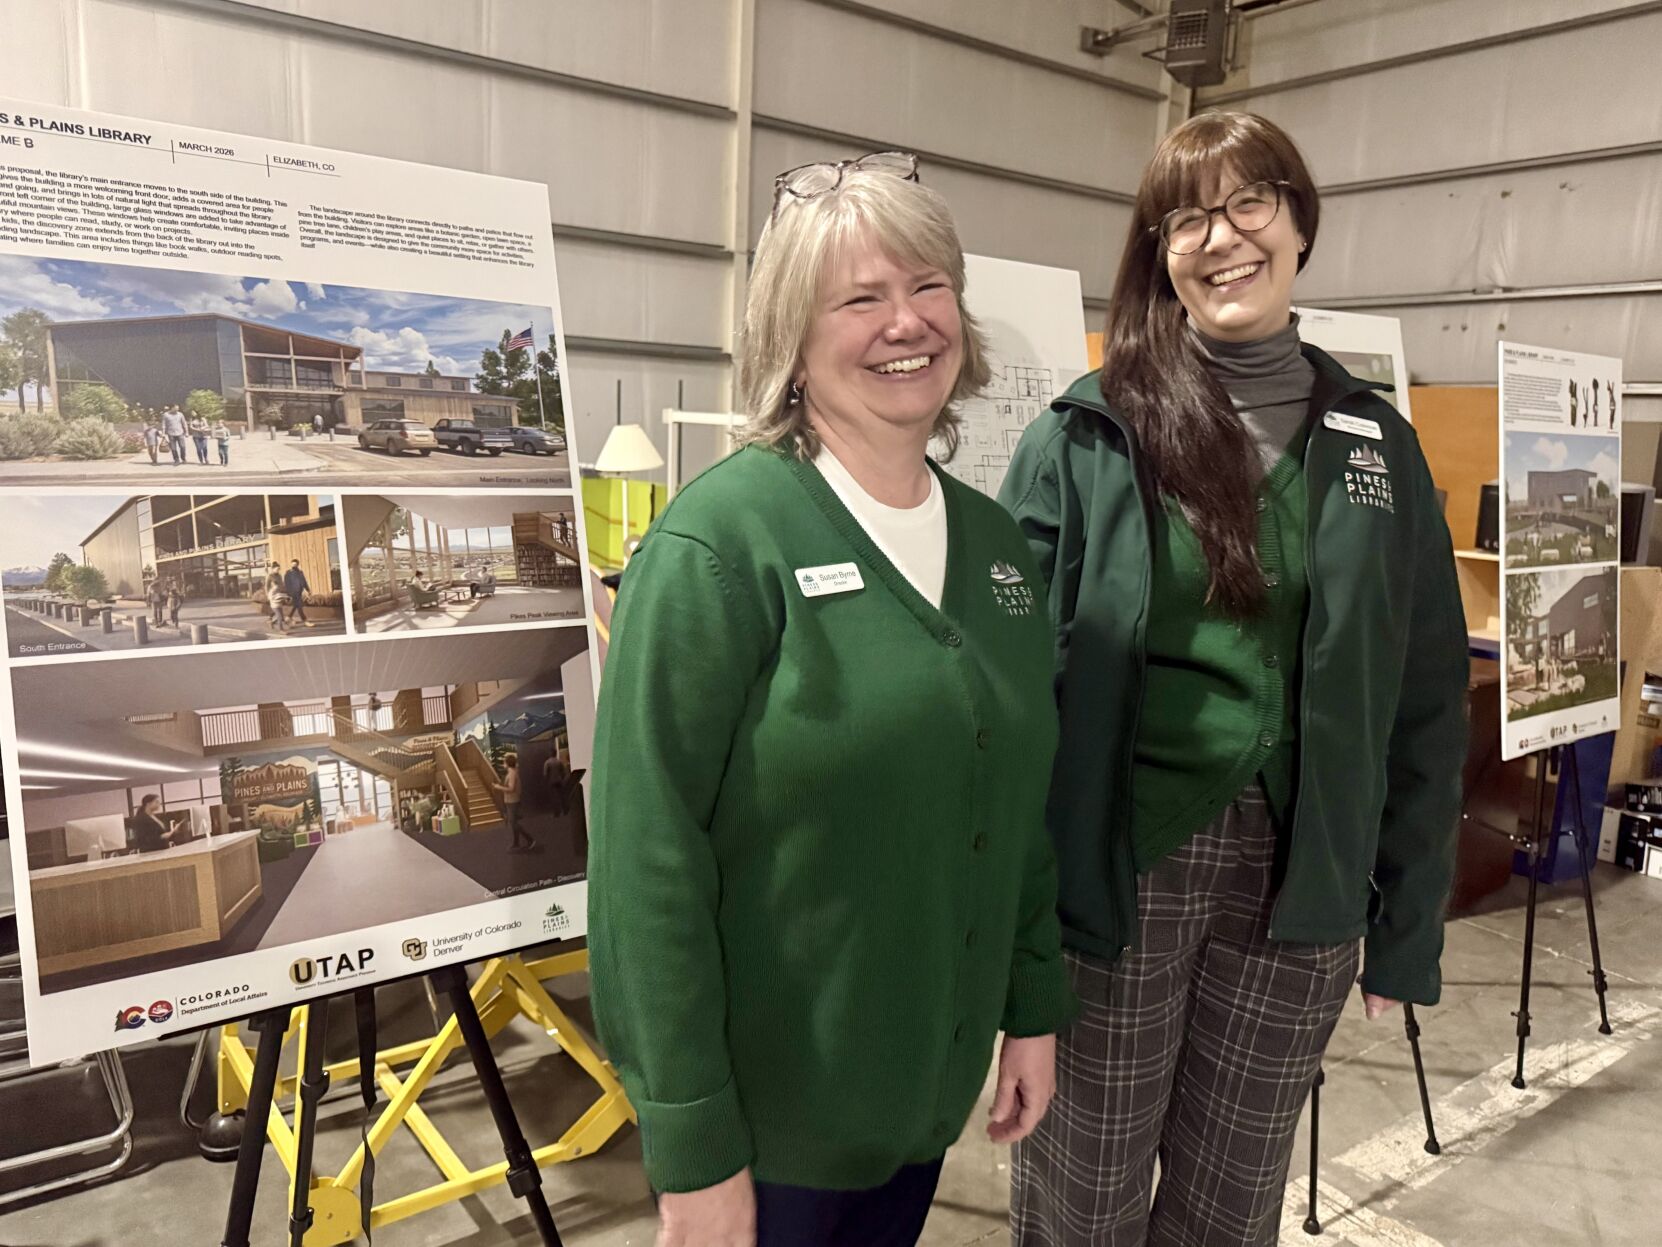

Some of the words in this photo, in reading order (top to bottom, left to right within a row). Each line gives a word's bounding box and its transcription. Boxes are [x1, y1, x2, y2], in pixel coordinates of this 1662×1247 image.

[0, 112, 9, 124] S
[14, 115, 25, 126] &
[29, 117, 84, 135] PLAINS
[89, 126, 152, 144] LIBRARY
[0, 134, 21, 146] ME
[24, 138, 34, 148] B
[178, 142, 212, 153] MARCH
[214, 147, 235, 157] 2026
[273, 156, 321, 170] ELIZABETH,
[322, 164, 335, 172] CO
[59, 171, 89, 182] library's
[110, 179, 142, 188] entrance
[35, 176, 65, 188] building
[95, 185, 133, 197] welcoming
[135, 189, 151, 197] front
[252, 206, 274, 214] people
[58, 188, 81, 198] brings
[115, 196, 140, 204] natural
[142, 198, 156, 207] light
[202, 206, 238, 216] throughout
[30, 194, 56, 202] corner
[113, 203, 131, 213] large
[133, 206, 152, 214] glass
[154, 208, 184, 217] windows
[198, 214, 220, 222] added
[245, 219, 278, 230] advantage
[20, 235, 43, 243] where
[46, 237, 74, 247] families
[92, 244, 112, 252] enjoy
[131, 246, 160, 256] together
[100, 235, 130, 244] includes
[132, 238, 154, 248] things
[238, 251, 262, 260] reading
[1345, 472, 1386, 489] PINES
[1347, 483, 1393, 503] PLAINS
[992, 586, 1026, 596] PINES
[996, 596, 1033, 606] PLAIN
[234, 786, 260, 798] PINES
[276, 780, 308, 792] PLAINS
[484, 888, 506, 898] Central
[507, 881, 538, 894] Circulation
[432, 932, 473, 946] University
[474, 929, 483, 937] of
[485, 920, 522, 935] Colorado
[433, 944, 463, 957] Denver
[292, 948, 374, 984] UTAP
[180, 984, 250, 1006] COLORADO
[181, 1002, 220, 1015] Department
[229, 996, 246, 1004] Local
[247, 992, 268, 1001] Affairs
